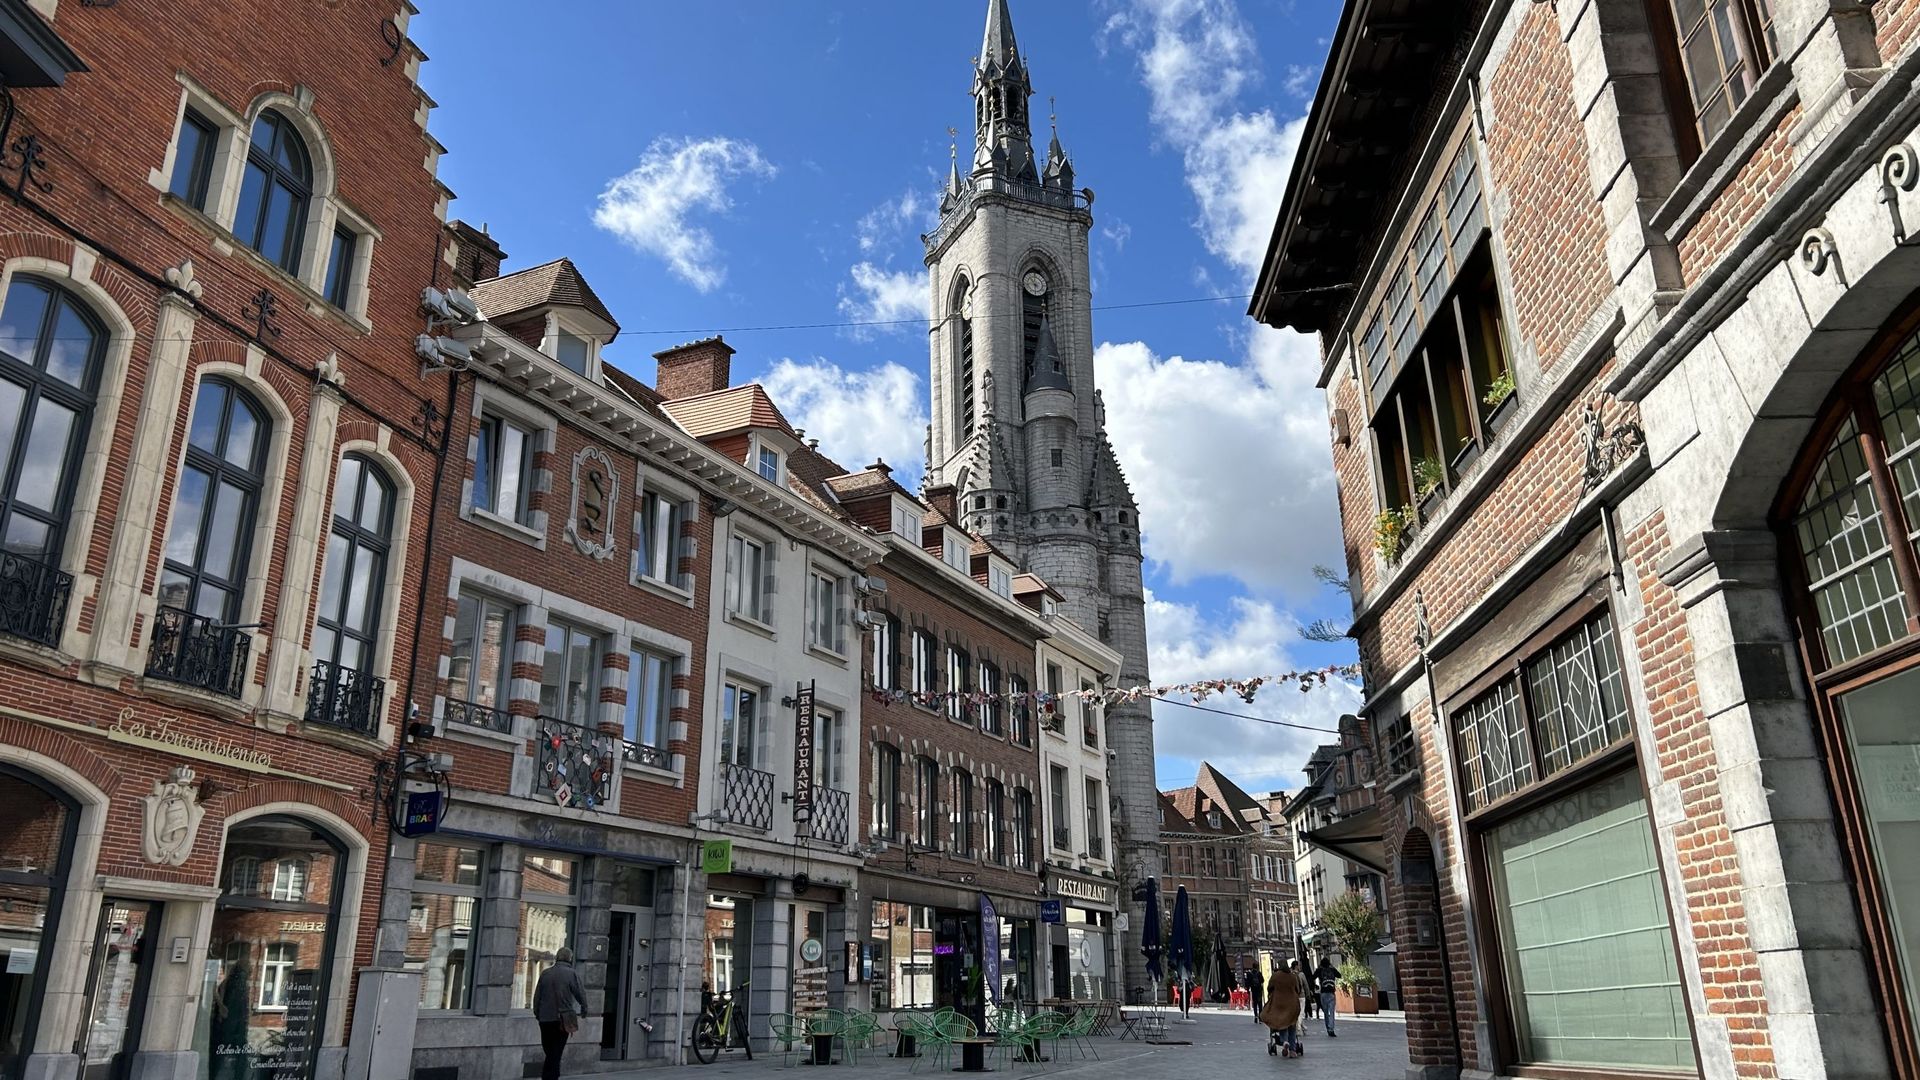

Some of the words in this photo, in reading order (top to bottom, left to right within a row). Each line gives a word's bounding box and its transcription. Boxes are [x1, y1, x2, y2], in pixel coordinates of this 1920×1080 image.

[110, 707, 146, 737] Les
[797, 696, 810, 800] RESTAURANT
[1057, 878, 1107, 902] RESTAURANT
